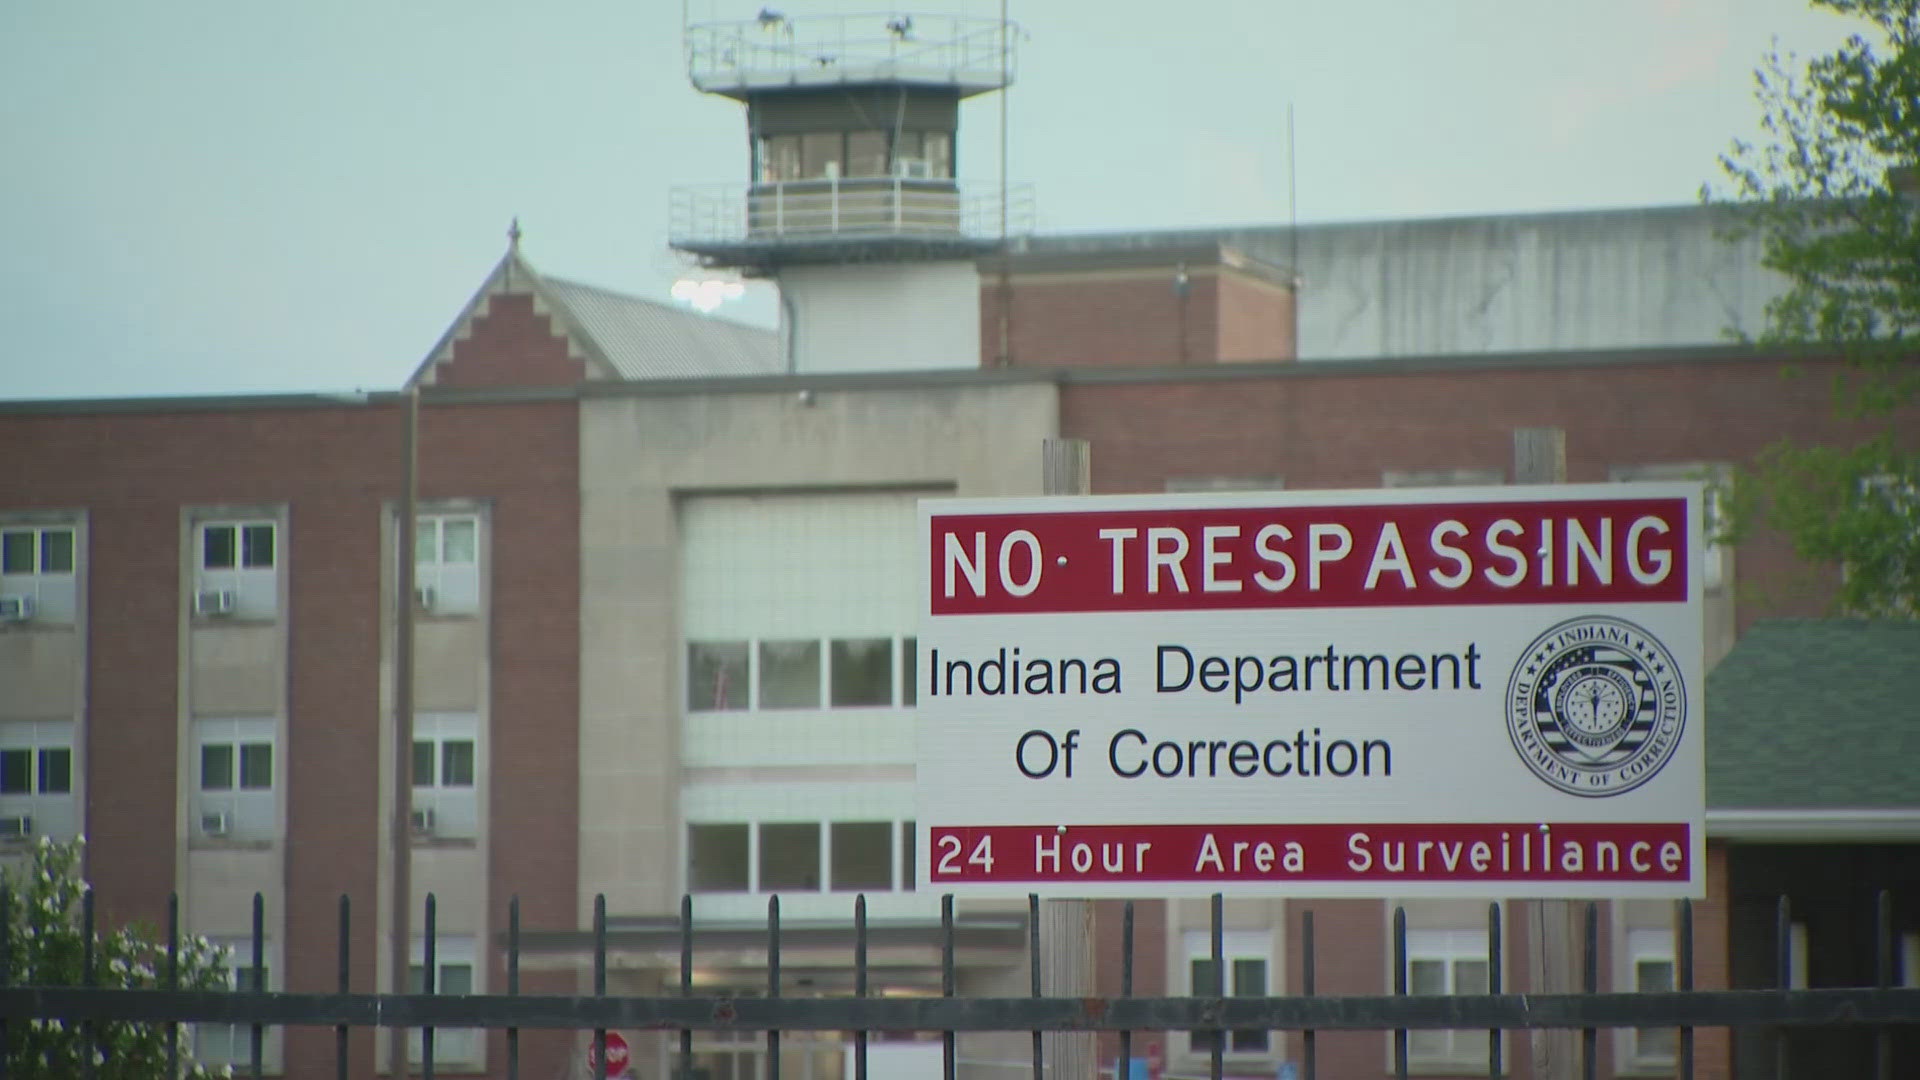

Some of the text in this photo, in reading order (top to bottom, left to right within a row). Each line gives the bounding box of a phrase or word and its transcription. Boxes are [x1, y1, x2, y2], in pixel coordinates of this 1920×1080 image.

[944, 516, 1673, 598] NO TRESPASSING
[1558, 626, 1630, 648] INDIANA
[930, 642, 1482, 705] Indiana Department
[1015, 727, 1391, 780] Of Correction
[1515, 682, 1581, 785] DEPARTMENT
[1589, 773, 1610, 787] OF
[1619, 679, 1678, 782] CORRECTION
[937, 832, 1682, 874] 24 Hour Area Surveillance
